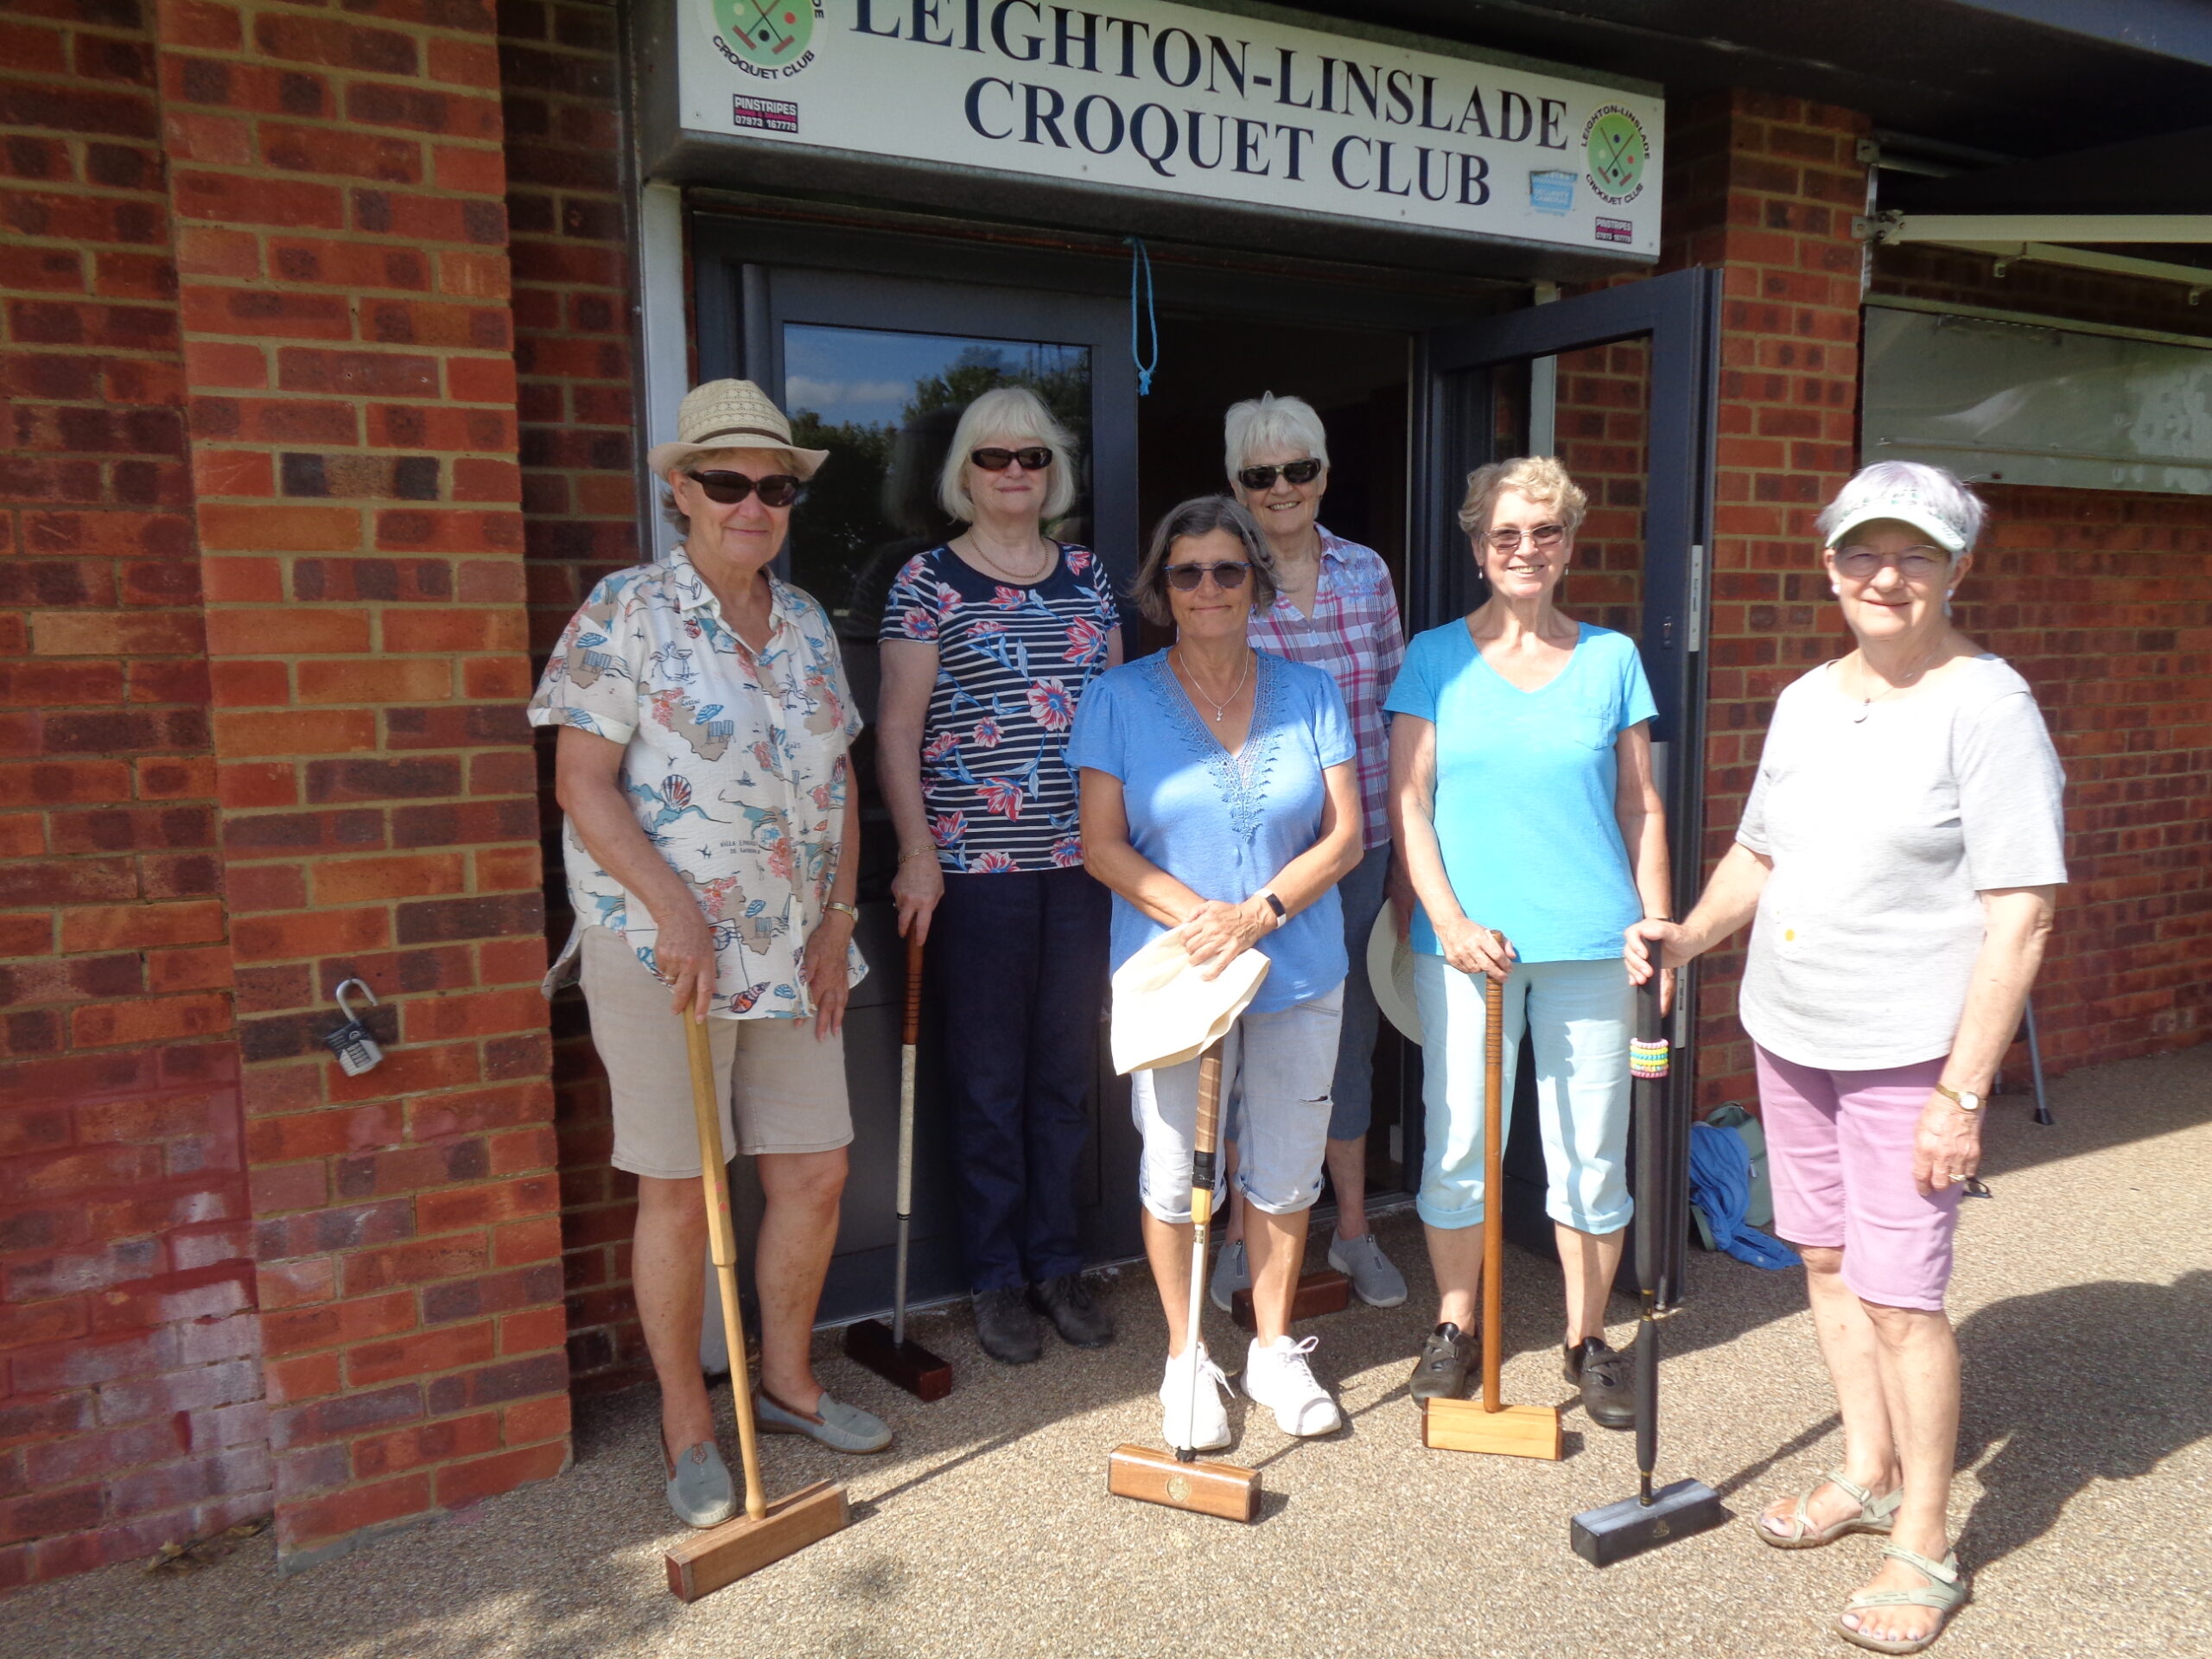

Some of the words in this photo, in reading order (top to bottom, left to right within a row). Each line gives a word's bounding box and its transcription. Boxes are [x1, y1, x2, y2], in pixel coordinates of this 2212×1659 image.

[713, 35, 779, 79] CROQUET
[783, 49, 815, 77] CLUB
[849, 0, 1568, 150] LEIGHTON-LINSLADE
[734, 96, 797, 115] PINSTRIPES
[735, 114, 763, 127] 07973
[766, 119, 797, 131] 167779
[964, 76, 1313, 181] CROQUET
[1332, 135, 1491, 207] CLUB
[1580, 105, 1650, 159] LEIGHTON-LINSLADE
[1586, 174, 1623, 205] CROQUET
[1624, 182, 1643, 203] CLUB
